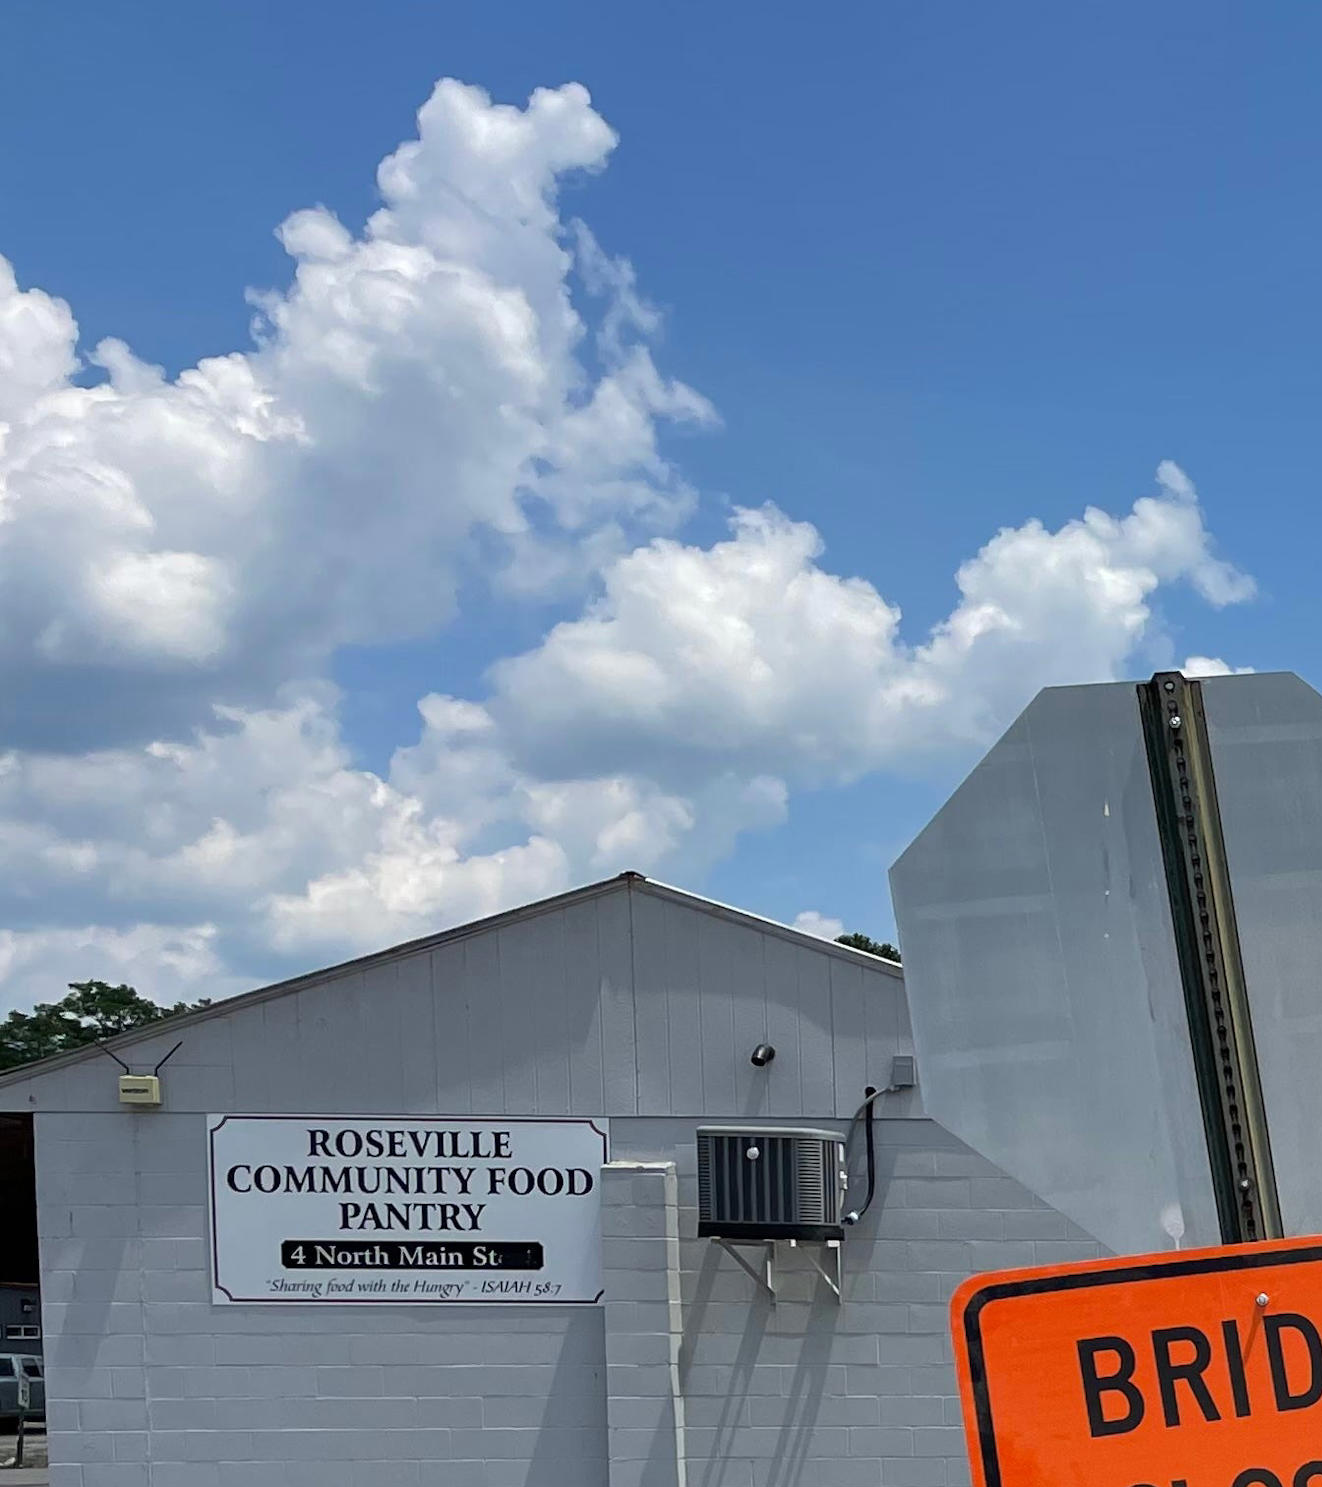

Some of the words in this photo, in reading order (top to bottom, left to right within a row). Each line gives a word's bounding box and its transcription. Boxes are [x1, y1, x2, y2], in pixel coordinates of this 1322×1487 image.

[307, 1129, 513, 1158] ROSEVILLE
[227, 1165, 476, 1194] COMMUNITY
[487, 1167, 593, 1196] FOOD
[339, 1203, 486, 1231] PANTRY
[291, 1246, 306, 1265] 4
[315, 1246, 390, 1266] North
[399, 1247, 464, 1266] Main
[326, 1278, 355, 1295] food
[357, 1279, 386, 1292] with
[390, 1279, 410, 1292] the
[481, 1281, 532, 1293] ISAIAH
